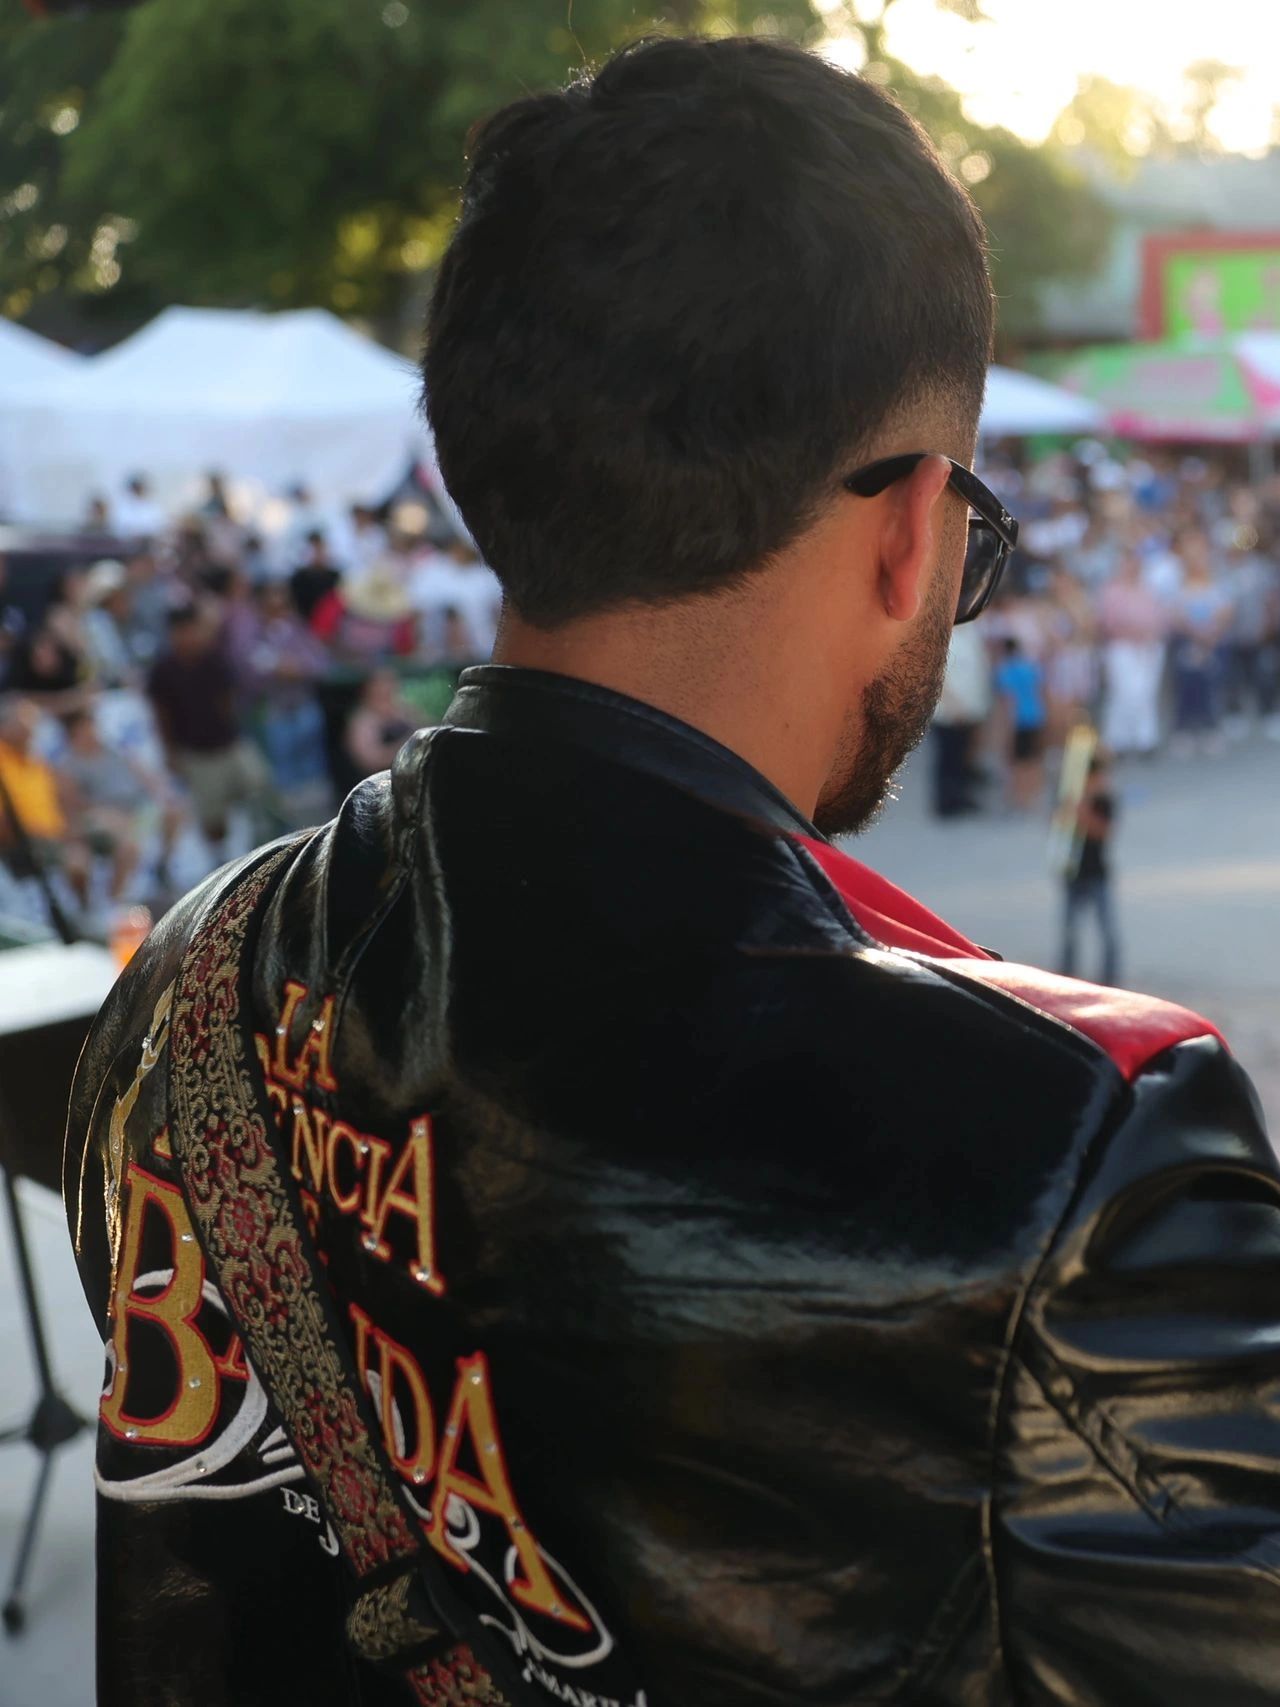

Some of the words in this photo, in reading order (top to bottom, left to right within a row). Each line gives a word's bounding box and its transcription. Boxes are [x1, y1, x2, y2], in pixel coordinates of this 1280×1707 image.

[271, 979, 339, 1092] LA
[265, 1081, 447, 1297] NCIA
[279, 1486, 321, 1525] DE
